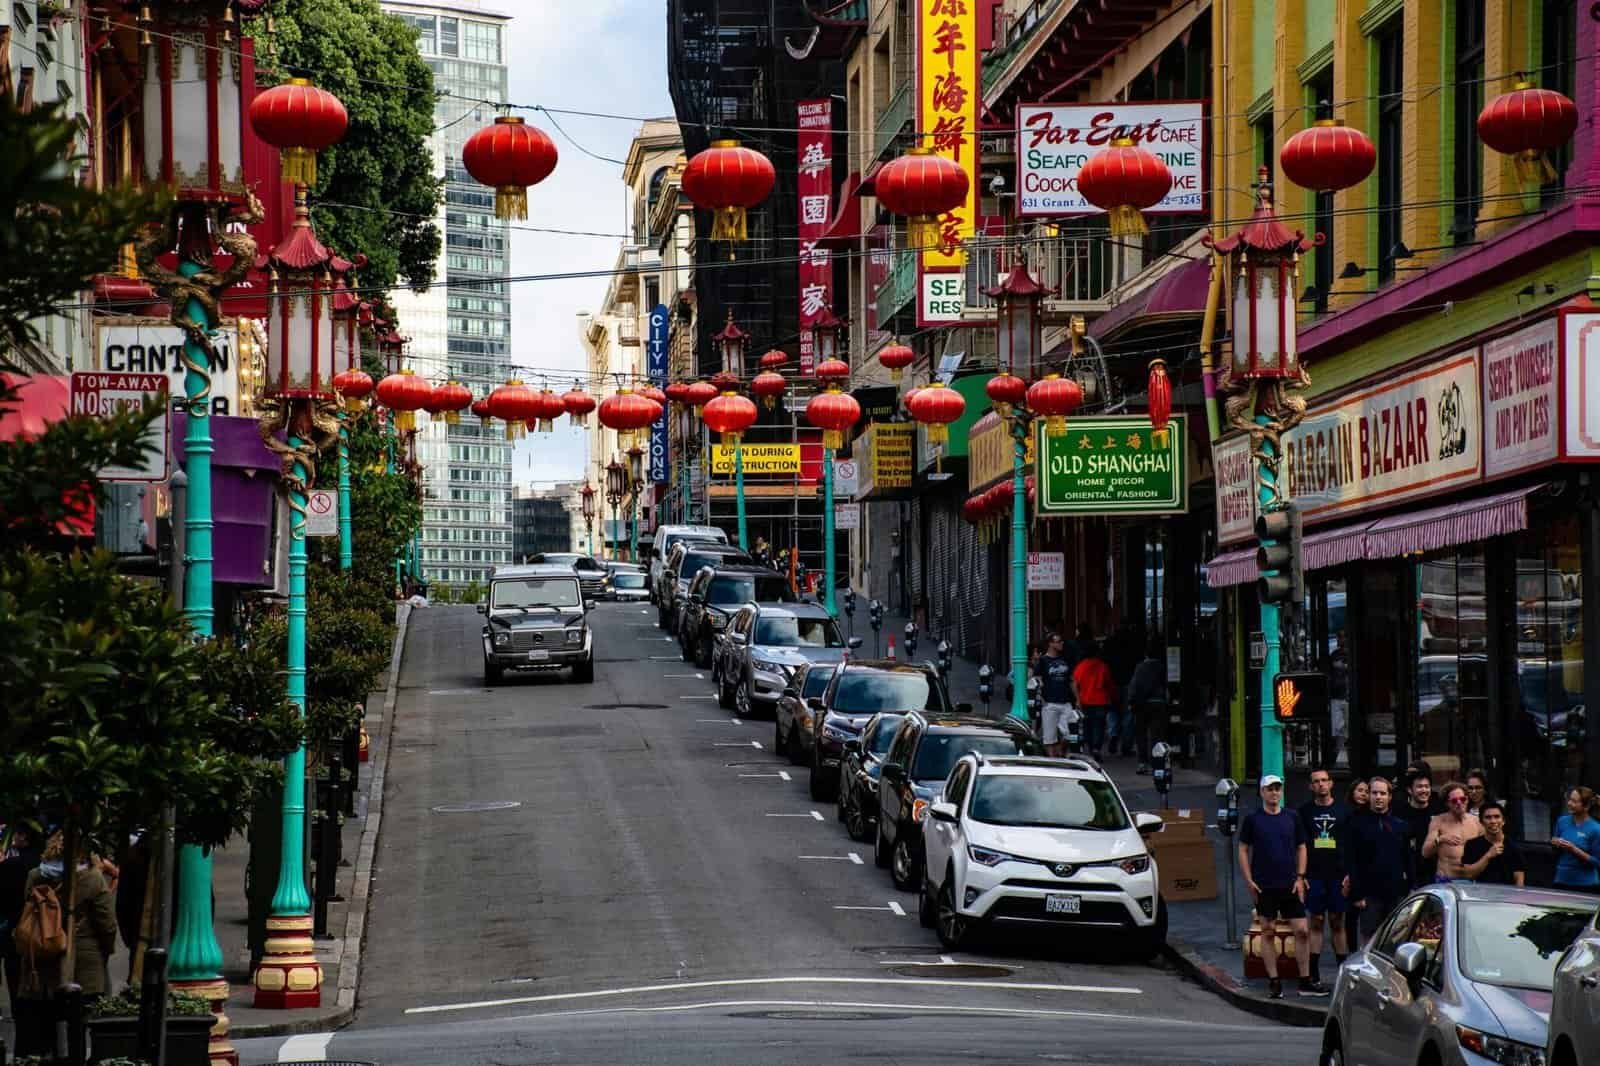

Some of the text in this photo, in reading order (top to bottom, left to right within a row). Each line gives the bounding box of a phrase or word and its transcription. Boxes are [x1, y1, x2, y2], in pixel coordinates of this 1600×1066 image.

[800, 115, 831, 128] CHINATOWN
[930, 0, 967, 257] 年海鮮家
[1026, 112, 1196, 148] Far East CAFÉ
[1028, 150, 1088, 170] SEAFO
[1022, 199, 1037, 207] 631
[1042, 199, 1073, 207] Grant
[930, 301, 960, 314] RES
[652, 315, 663, 365] CITY
[106, 344, 229, 374] CANTN
[1489, 341, 1553, 402] SERVE YOURSELF
[78, 375, 162, 389] TOW-AWAY
[74, 391, 98, 416] NO
[1496, 394, 1549, 452] AND PAY LESS
[1079, 434, 1142, 449] 大上海
[1287, 397, 1430, 497] BARGAIN BAZAAR
[652, 432, 664, 480] KONG
[720, 447, 793, 457] OPN DURING
[716, 461, 798, 471] COTRUCTION
[1051, 453, 1170, 474] OLD SHANGHAI
[1077, 477, 1144, 486] HOME DECOR
[1064, 490, 1158, 500] ORIENTAL FASHION
